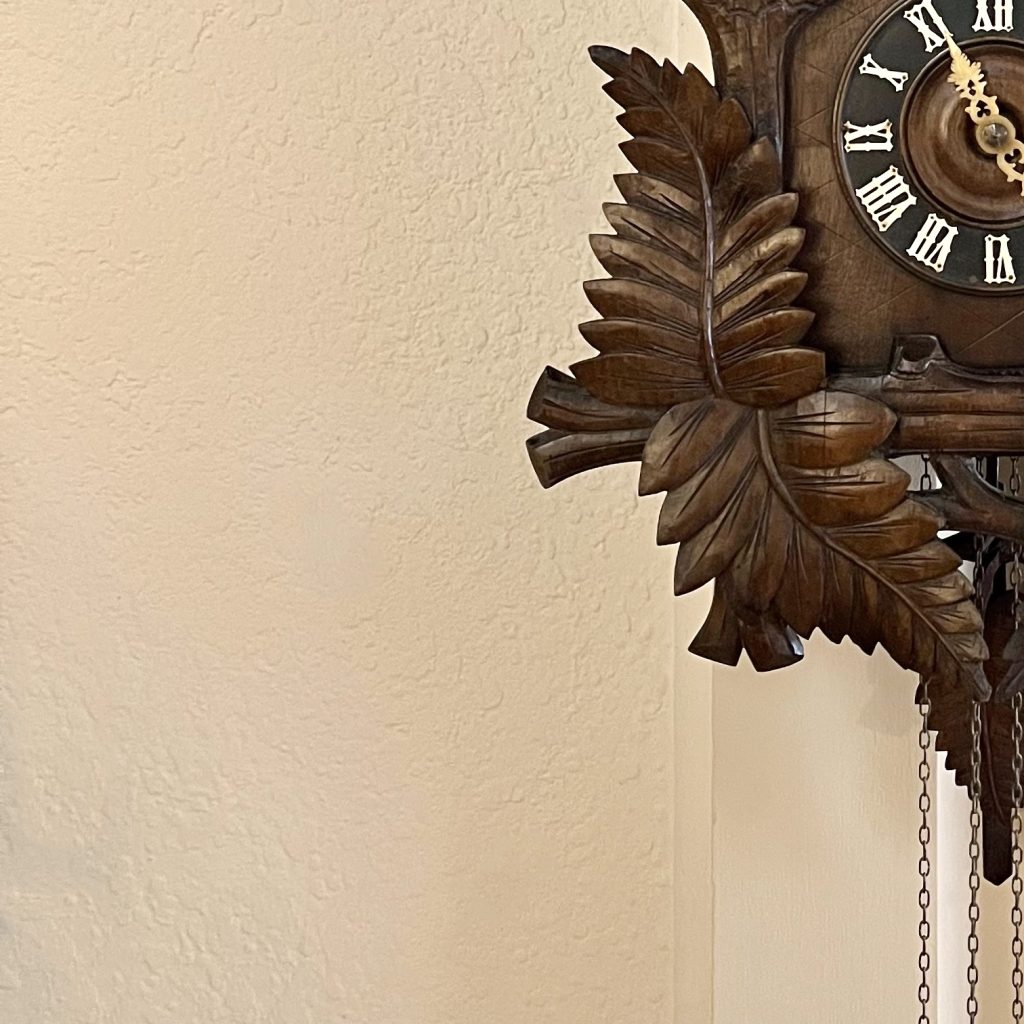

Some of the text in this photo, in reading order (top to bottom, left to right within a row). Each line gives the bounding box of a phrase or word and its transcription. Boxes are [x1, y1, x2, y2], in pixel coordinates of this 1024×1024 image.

[859, 53, 909, 92] X
[843, 119, 894, 153] IX
[855, 165, 917, 232] VIII
[906, 213, 959, 272] VII
[984, 234, 1016, 284] VI
